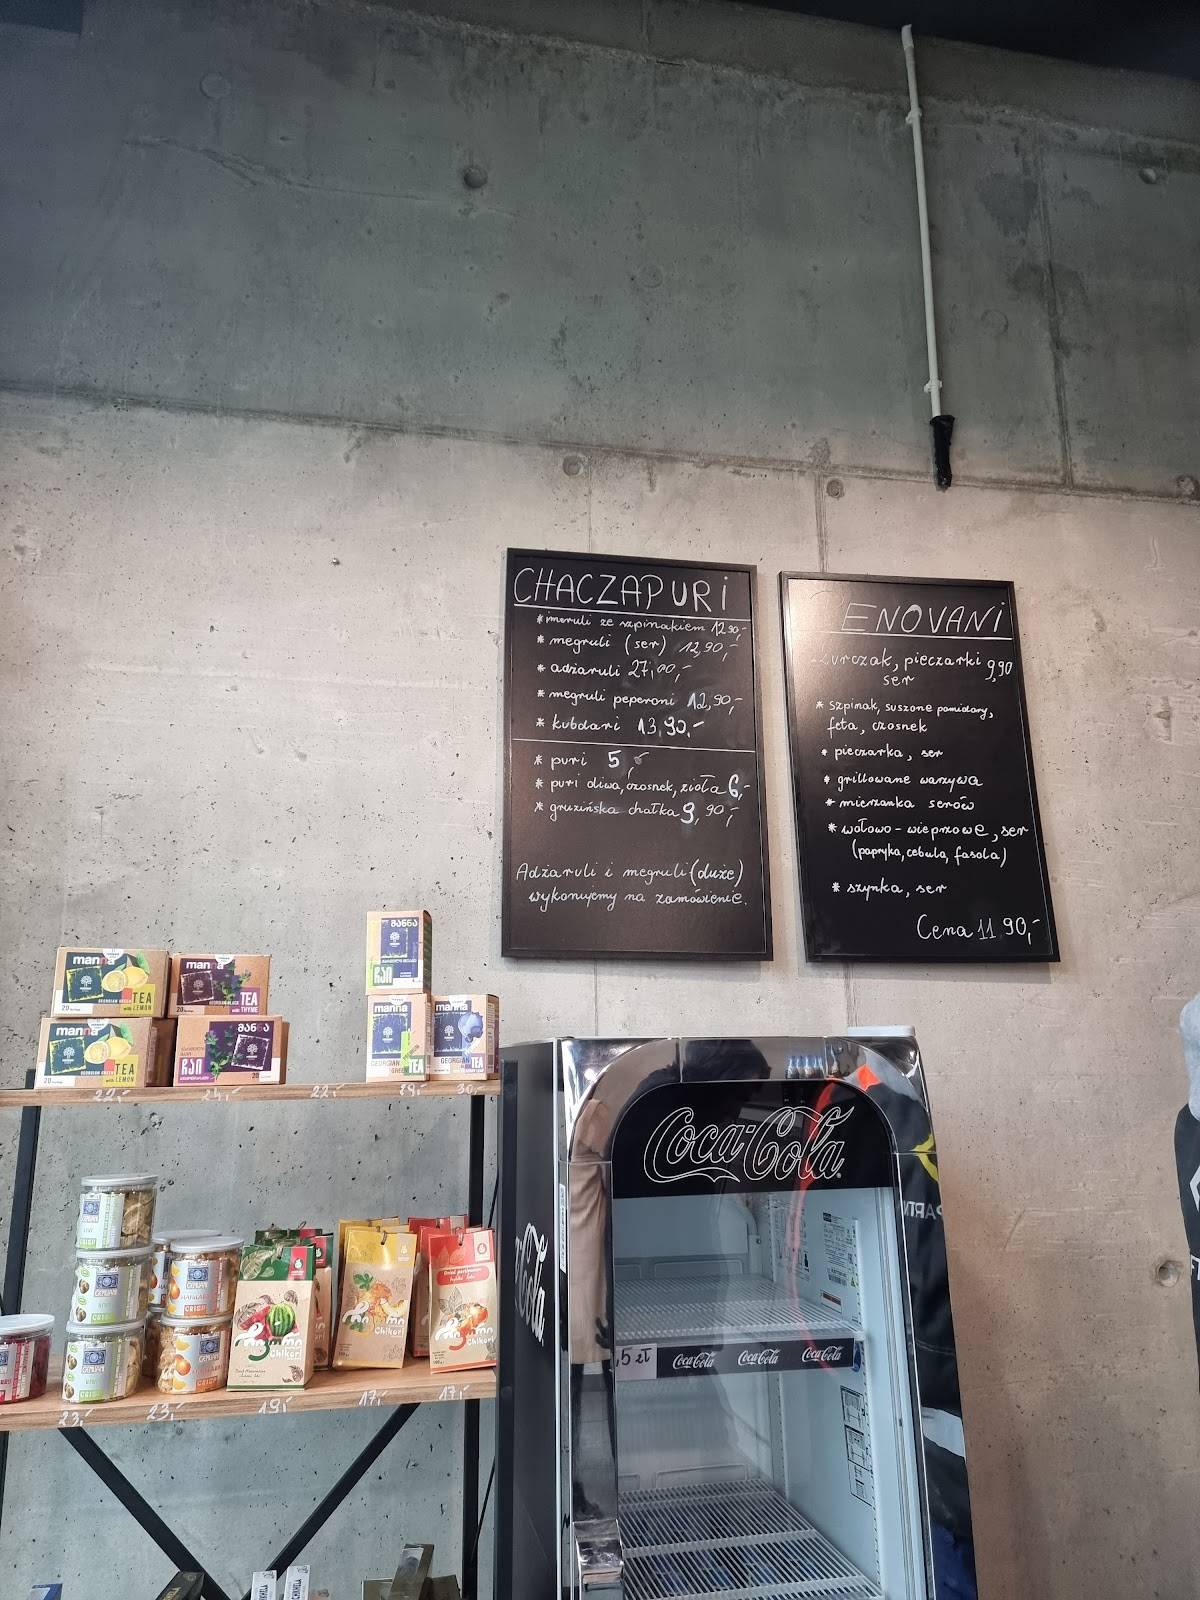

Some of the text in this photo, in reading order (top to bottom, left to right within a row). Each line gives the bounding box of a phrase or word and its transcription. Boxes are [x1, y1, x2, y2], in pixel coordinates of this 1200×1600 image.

[600, 618, 614, 627] ze
[620, 619, 707, 632] szpinakiem
[549, 634, 612, 654] megruli
[625, 634, 667, 656] (ser)
[904, 651, 982, 670] pieczarki
[883, 674, 915, 686] ser
[549, 689, 606, 706] megruli
[613, 693, 675, 709] peperoni
[829, 698, 993, 720] szpinak, suszone pomidory,
[552, 714, 621, 731] kubdari
[827, 717, 928, 739] feta, czosnek
[550, 752, 588, 770] puri
[834, 743, 944, 761] pieczarka, ser
[550, 774, 579, 793] puri
[626, 780, 677, 798] czosnek,
[680, 774, 727, 795] zioła
[837, 772, 984, 793] grillowane warzywa
[550, 800, 620, 822] gruzińska
[629, 801, 680, 818] chałka
[839, 796, 975, 811] mieszanka serów
[1001, 825, 1029, 837] ser
[953, 846, 1007, 868] fasola)
[516, 859, 744, 887] Adżaruli i megruli (duże)
[847, 877, 948, 901] szynka, ser
[529, 885, 617, 912] wykonujemy
[624, 893, 646, 903] na
[917, 913, 974, 940] Cena
[133, 992, 152, 1004] TEA
[240, 992, 258, 1006] TEA
[56, 1026, 99, 1036] manna
[115, 1063, 135, 1076] TEA
[409, 1059, 424, 1073] TEA
[471, 1057, 483, 1069] TEA
